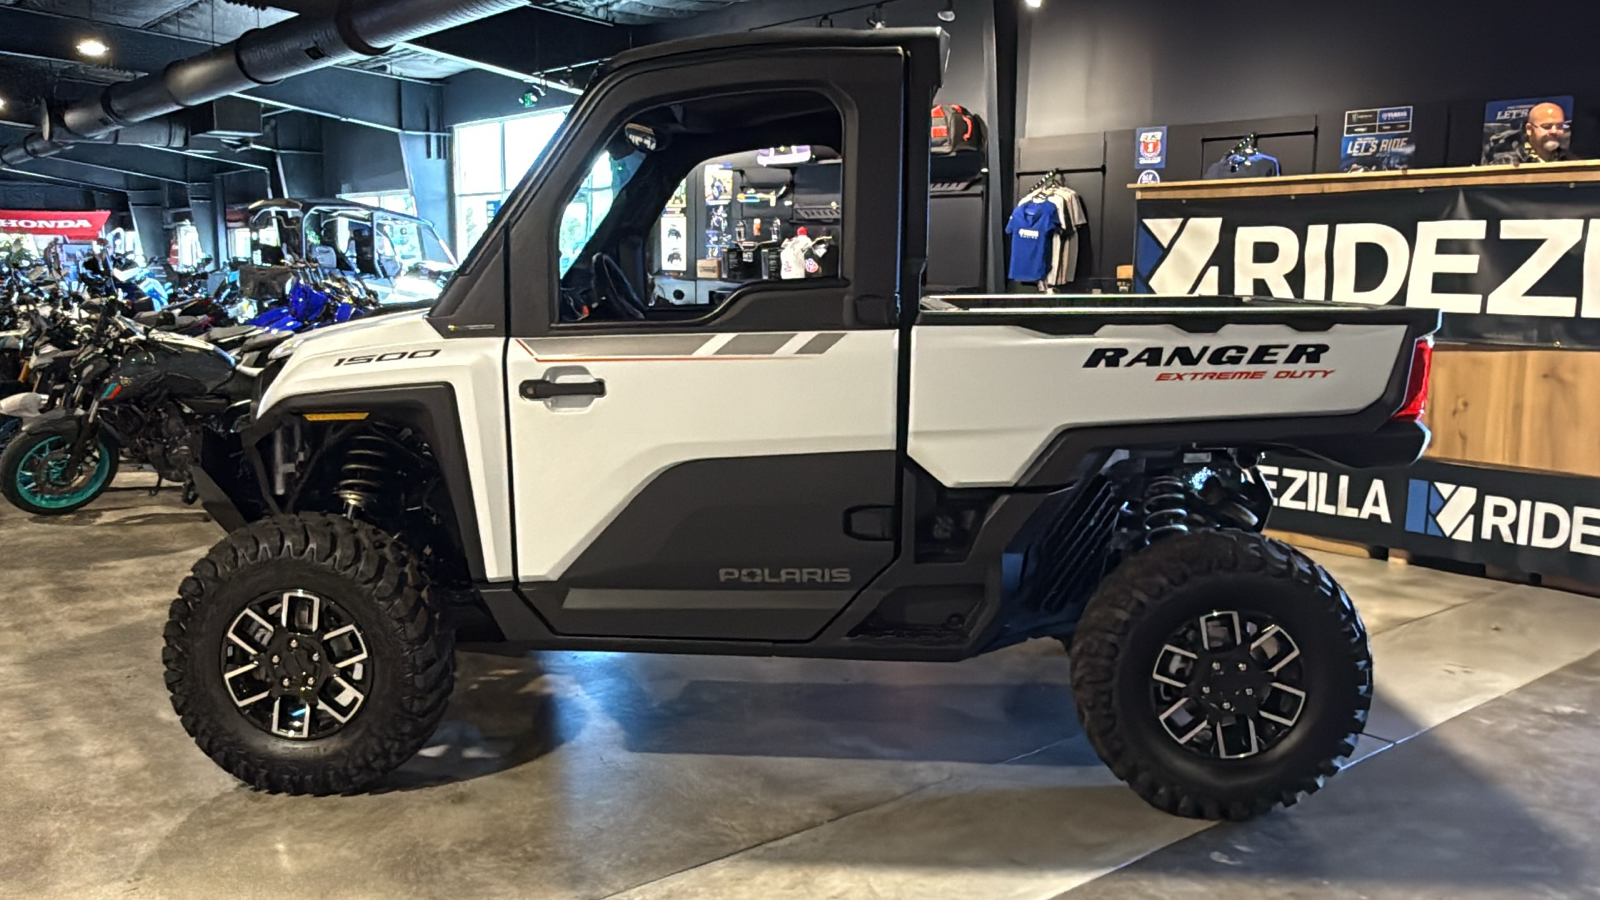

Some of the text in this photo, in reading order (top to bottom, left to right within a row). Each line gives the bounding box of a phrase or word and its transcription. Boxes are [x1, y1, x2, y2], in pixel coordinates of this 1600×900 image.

[1346, 140, 1379, 154] LET'S
[0, 219, 92, 228] HONDA
[333, 349, 442, 367] 1500
[1082, 344, 1330, 368] RANGER
[1155, 370, 1335, 381] EXTREME DUTY
[1481, 494, 1600, 557] RIDE
[718, 568, 851, 583] POLARIS
